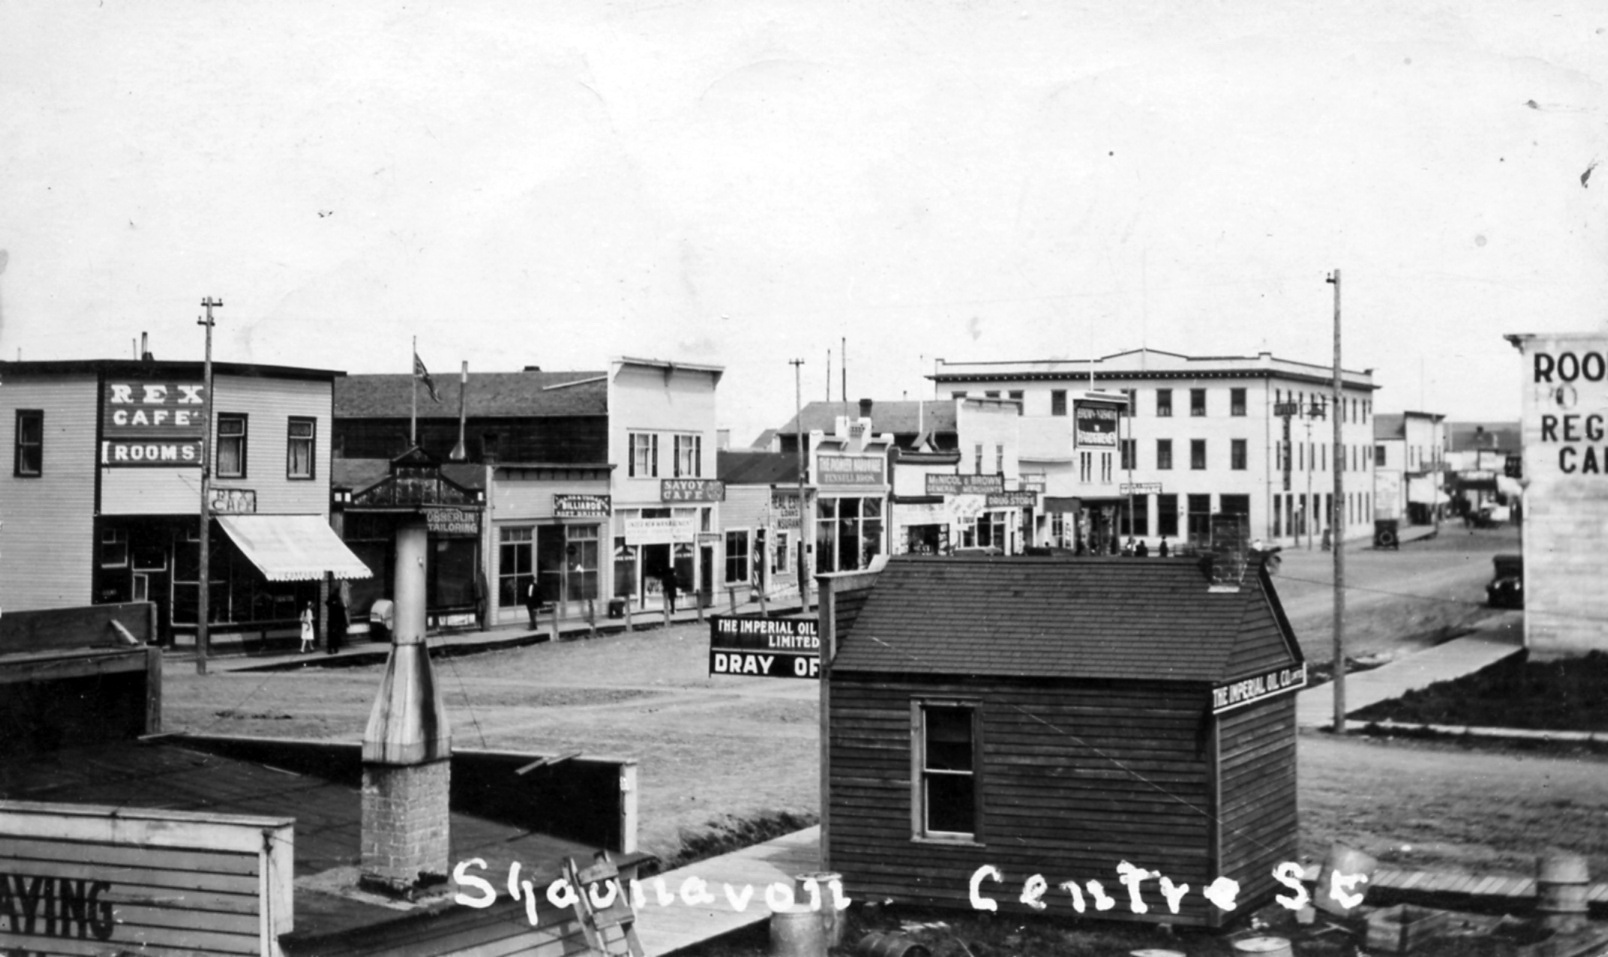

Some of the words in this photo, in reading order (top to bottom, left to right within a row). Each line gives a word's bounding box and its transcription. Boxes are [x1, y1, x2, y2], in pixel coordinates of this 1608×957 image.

[110, 384, 204, 404] REX
[1541, 414, 1604, 442] REG
[115, 445, 195, 460] ROOMS
[664, 480, 705, 490] SAVOY
[971, 476, 1001, 485] BROWN
[663, 490, 703, 500] CAFE
[561, 501, 602, 510] BILLIARDS
[427, 522, 478, 534] TAILORING
[718, 619, 738, 632] THE
[740, 620, 794, 634] IMPERIAL
[797, 622, 817, 635] OIL
[768, 635, 820, 648] LIMITED
[714, 653, 775, 675] DRAY
[1229, 677, 1266, 703] IMPERIAL
[1266, 672, 1280, 691] OIL
